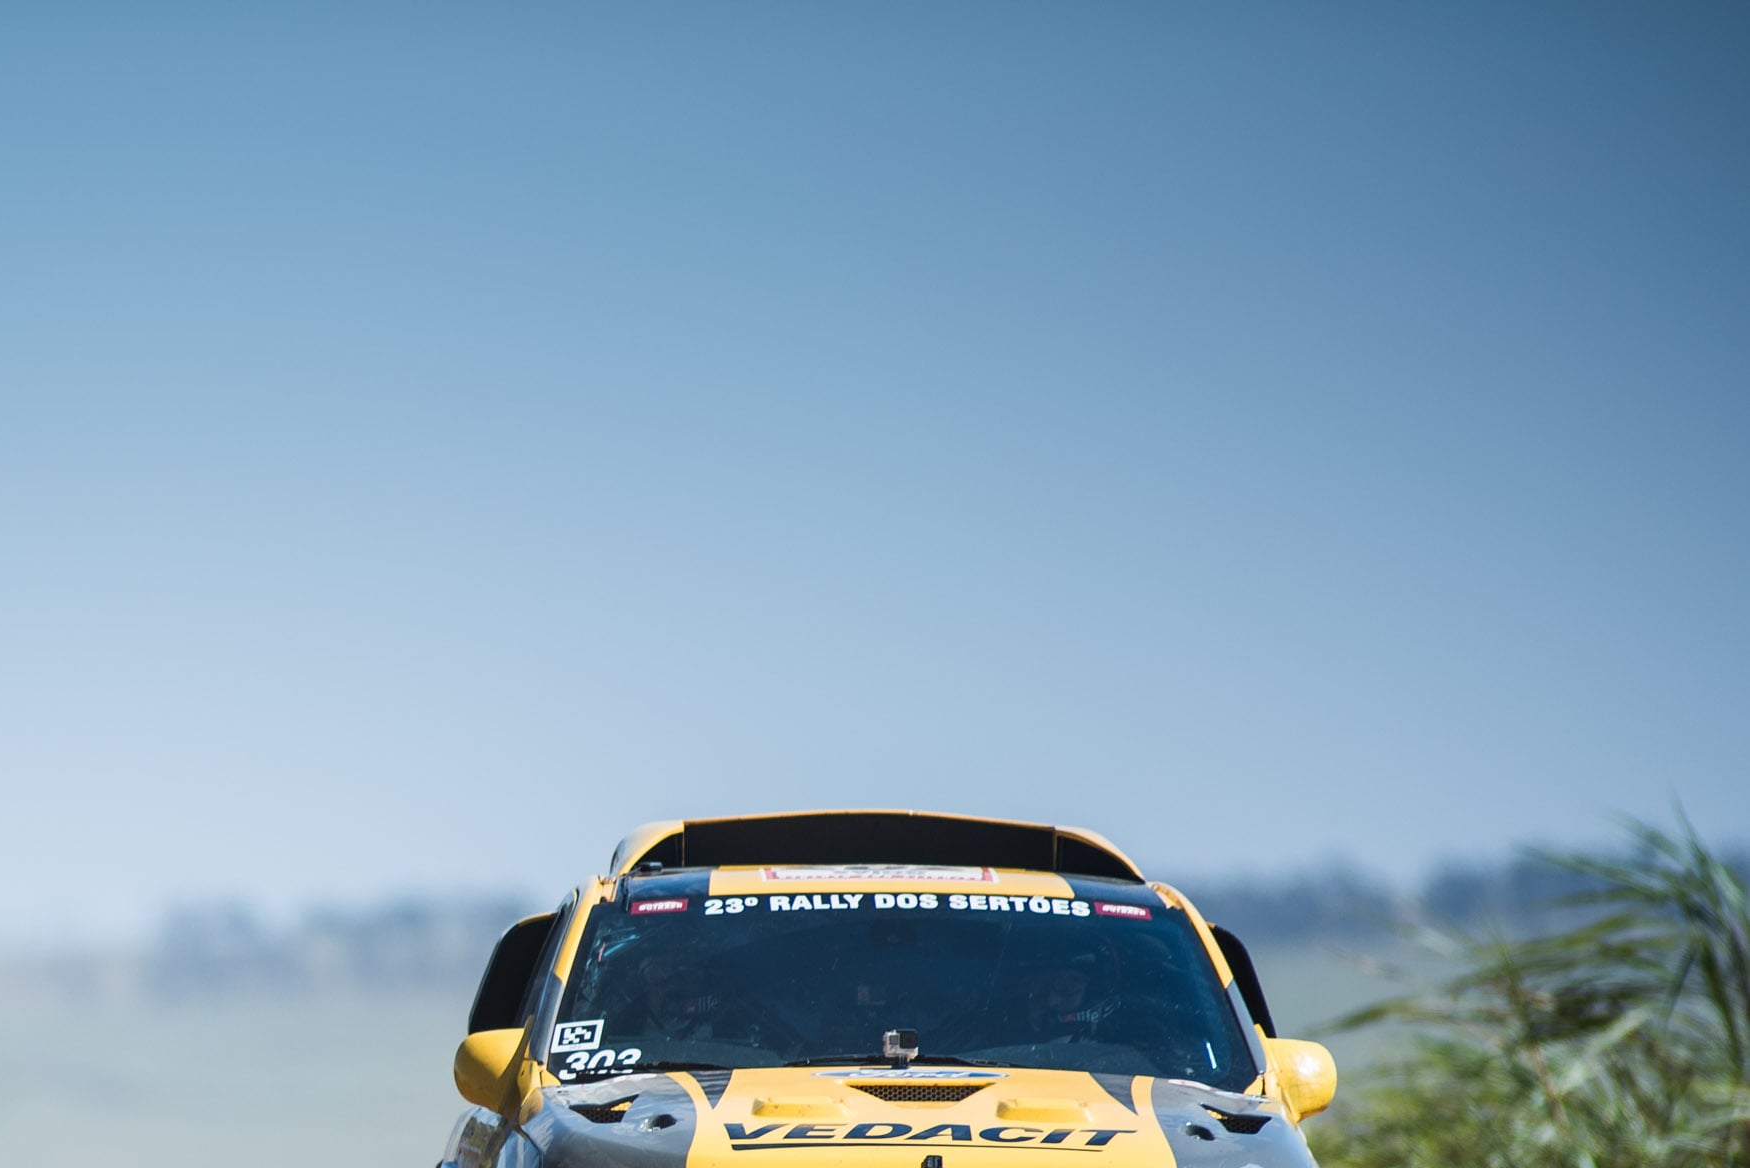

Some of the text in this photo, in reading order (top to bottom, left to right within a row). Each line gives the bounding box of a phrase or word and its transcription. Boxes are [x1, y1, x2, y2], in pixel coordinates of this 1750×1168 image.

[770, 894, 863, 911] RALLY
[874, 893, 938, 909] DOS
[949, 894, 1090, 917] SERTÕES
[723, 1122, 1138, 1146] VEDACIT
